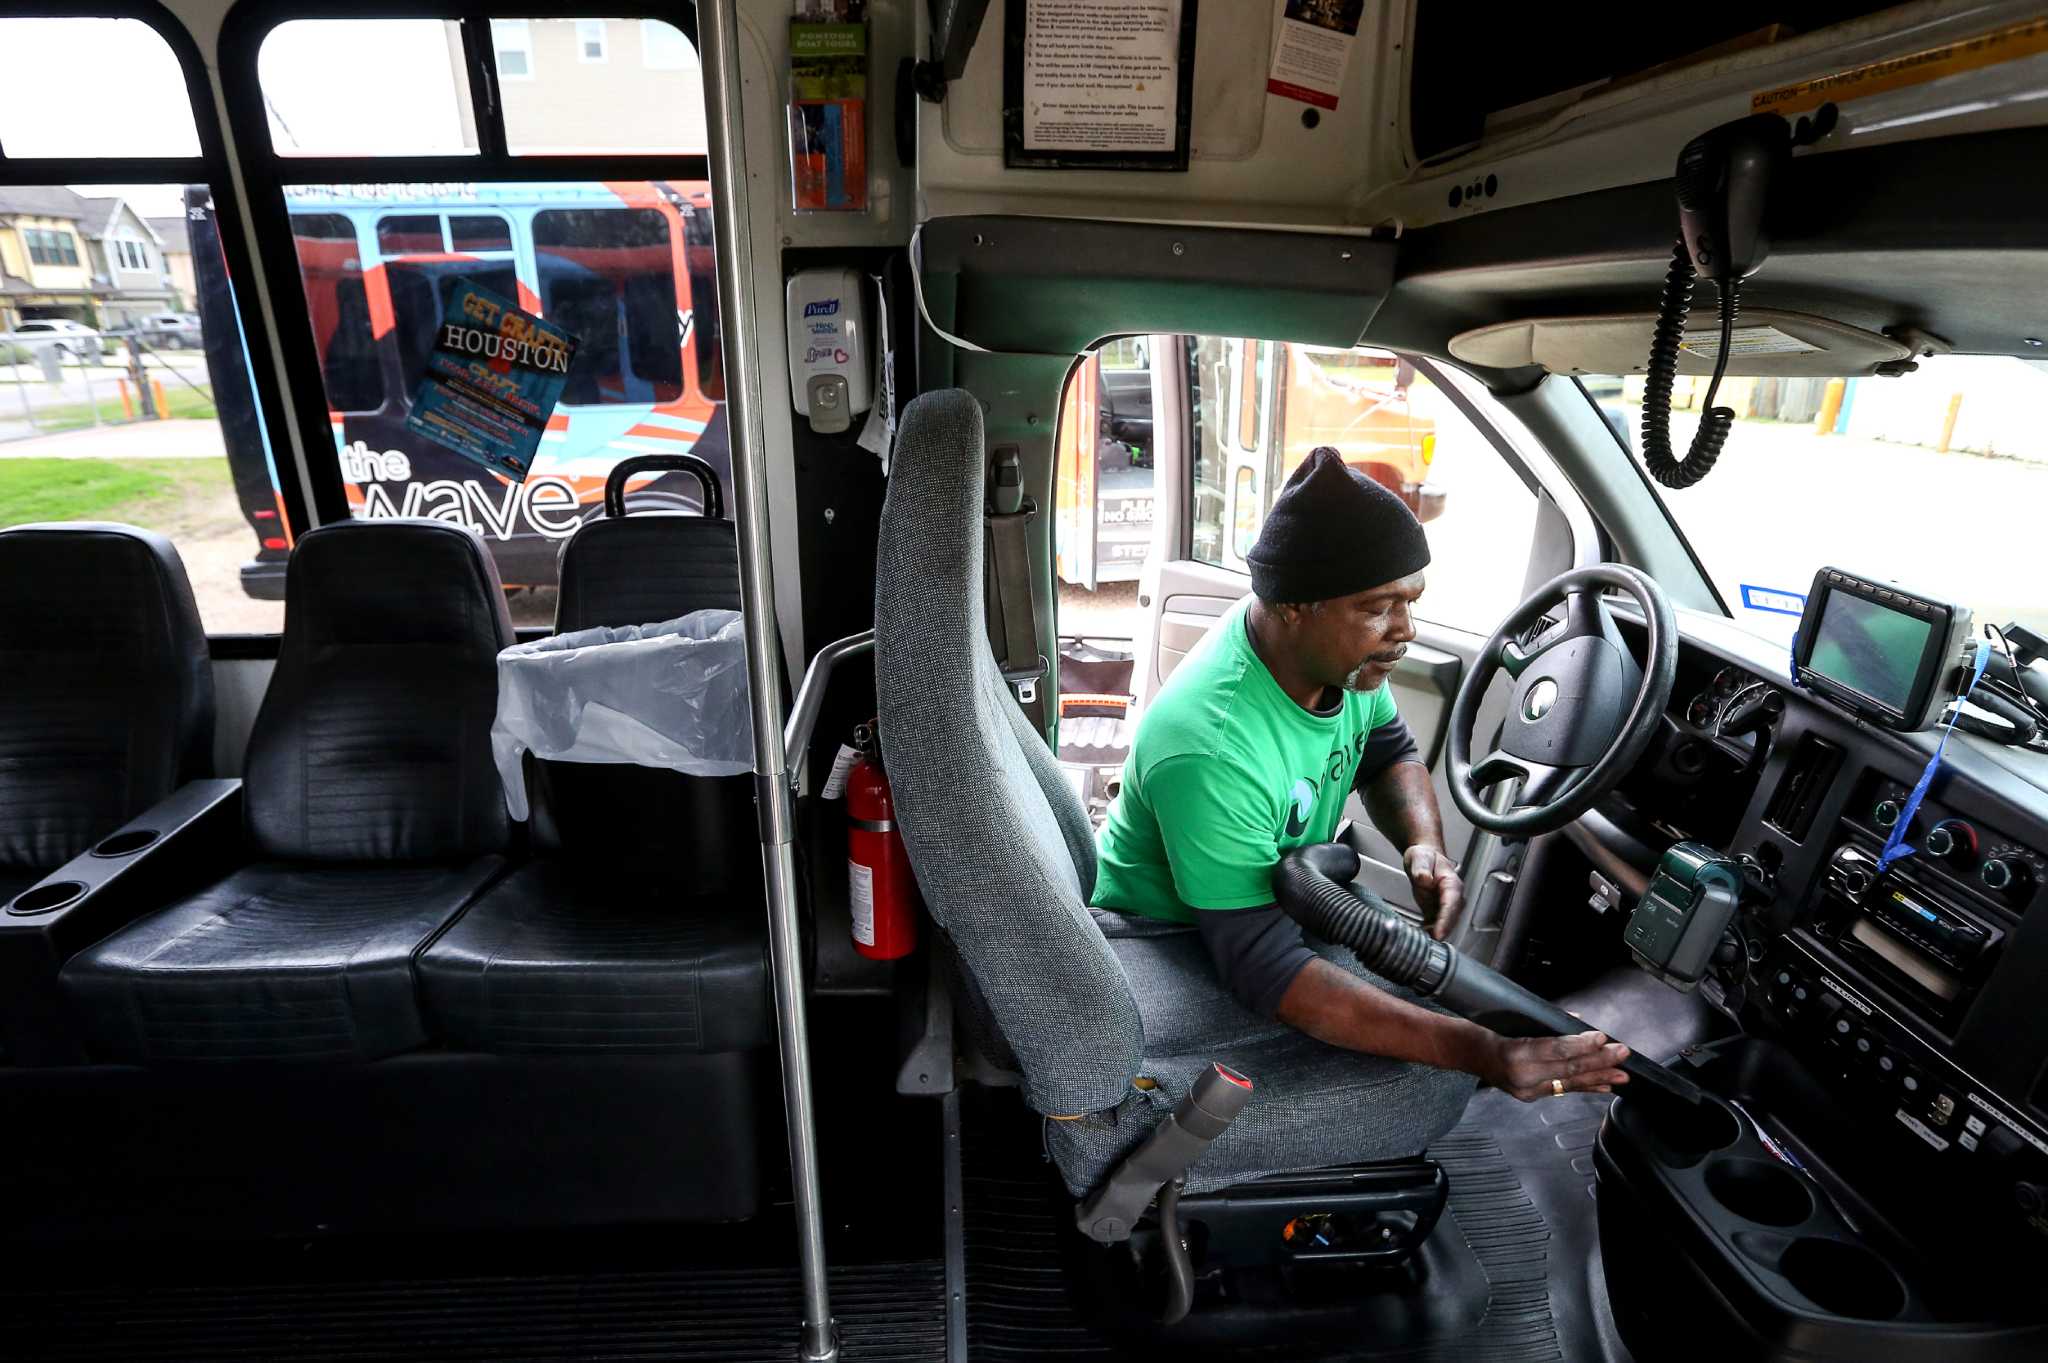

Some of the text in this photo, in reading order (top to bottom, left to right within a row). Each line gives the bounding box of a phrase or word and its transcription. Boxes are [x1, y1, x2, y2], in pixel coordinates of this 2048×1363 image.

[444, 323, 568, 374] HOUSTON
[343, 440, 411, 483] the
[1104, 511, 1153, 522] NO SMO
[1120, 499, 1153, 512] PLEA
